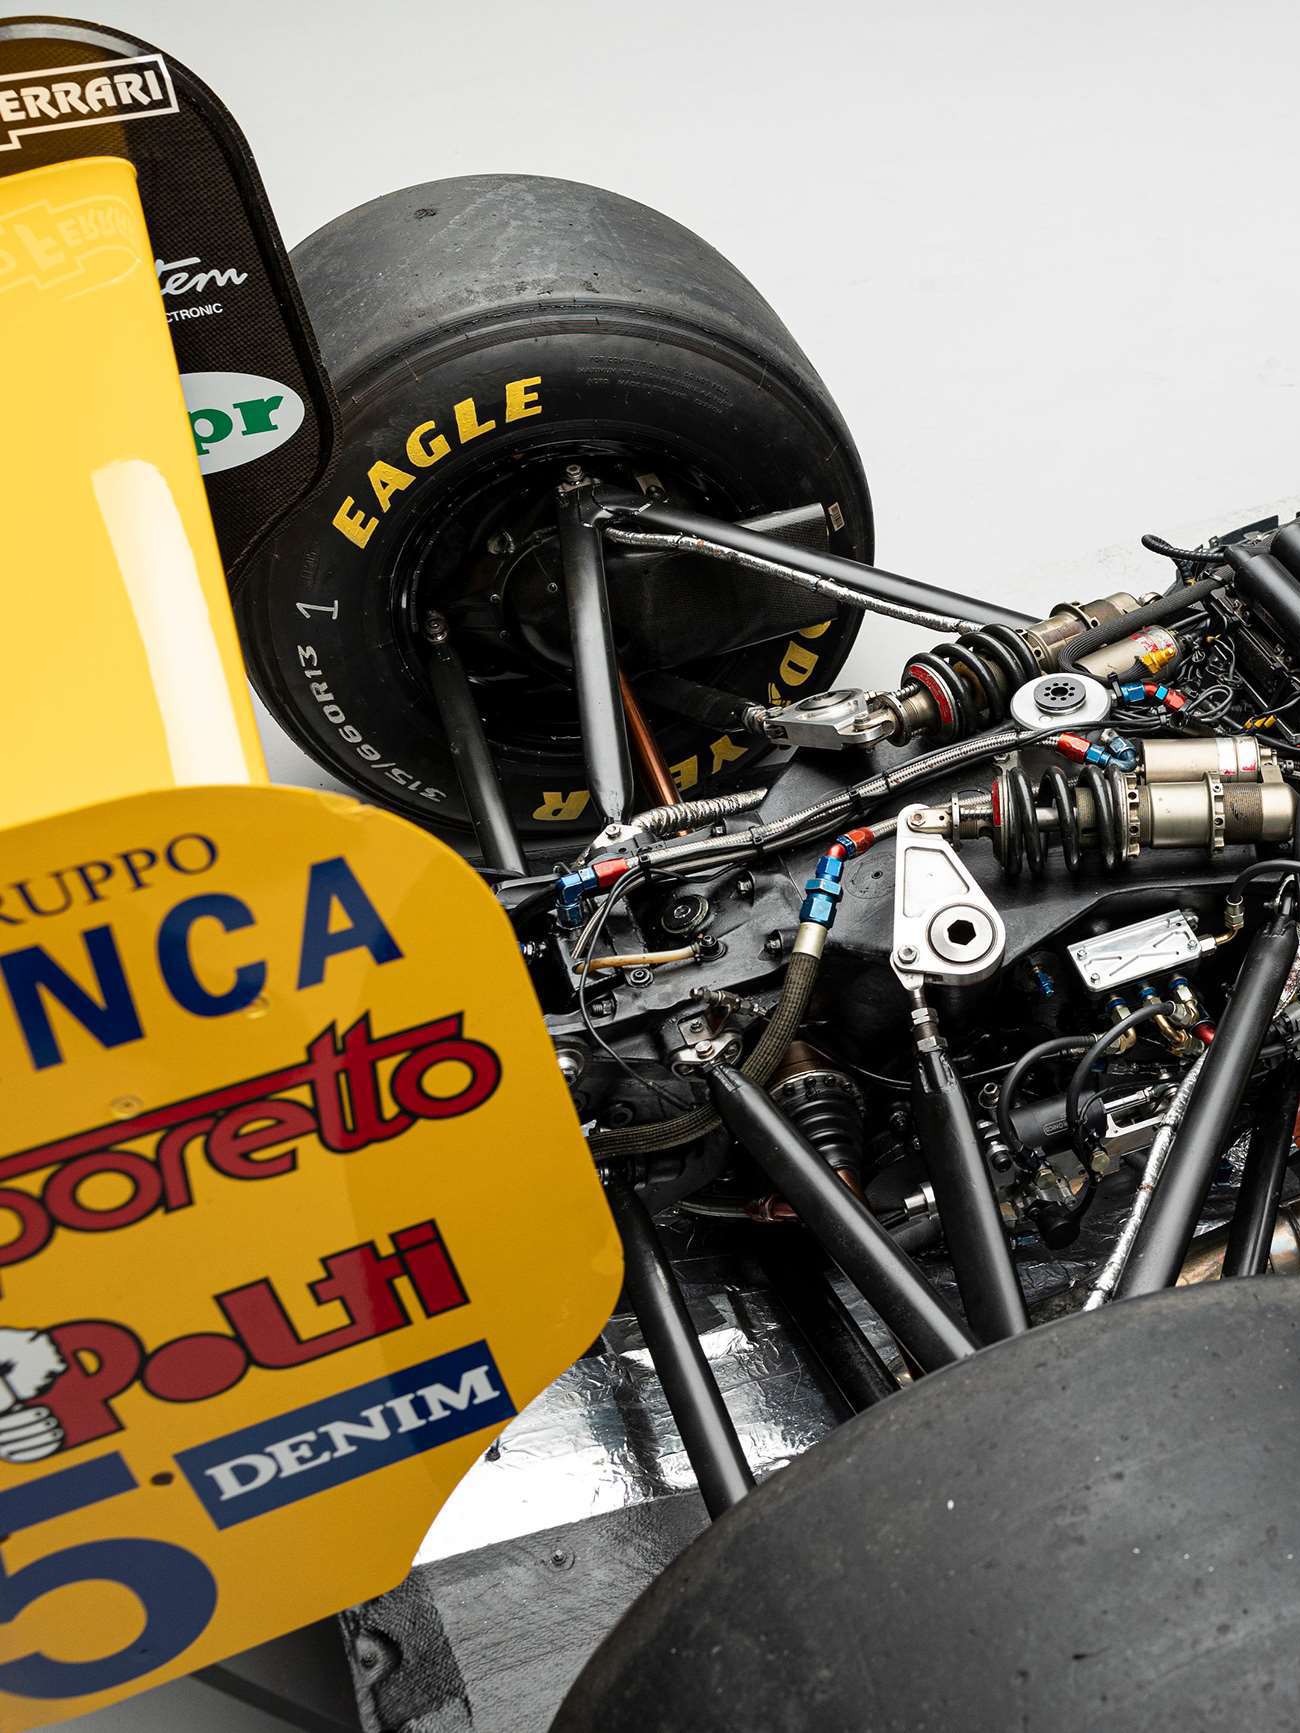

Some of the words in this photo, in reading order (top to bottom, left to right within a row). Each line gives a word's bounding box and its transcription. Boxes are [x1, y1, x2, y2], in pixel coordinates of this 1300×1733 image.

[332, 376, 543, 550] EAGLE
[297, 644, 447, 803] 315/660R13
[203, 1364, 501, 1502] DENIM
[0, 1449, 219, 1701] 5
